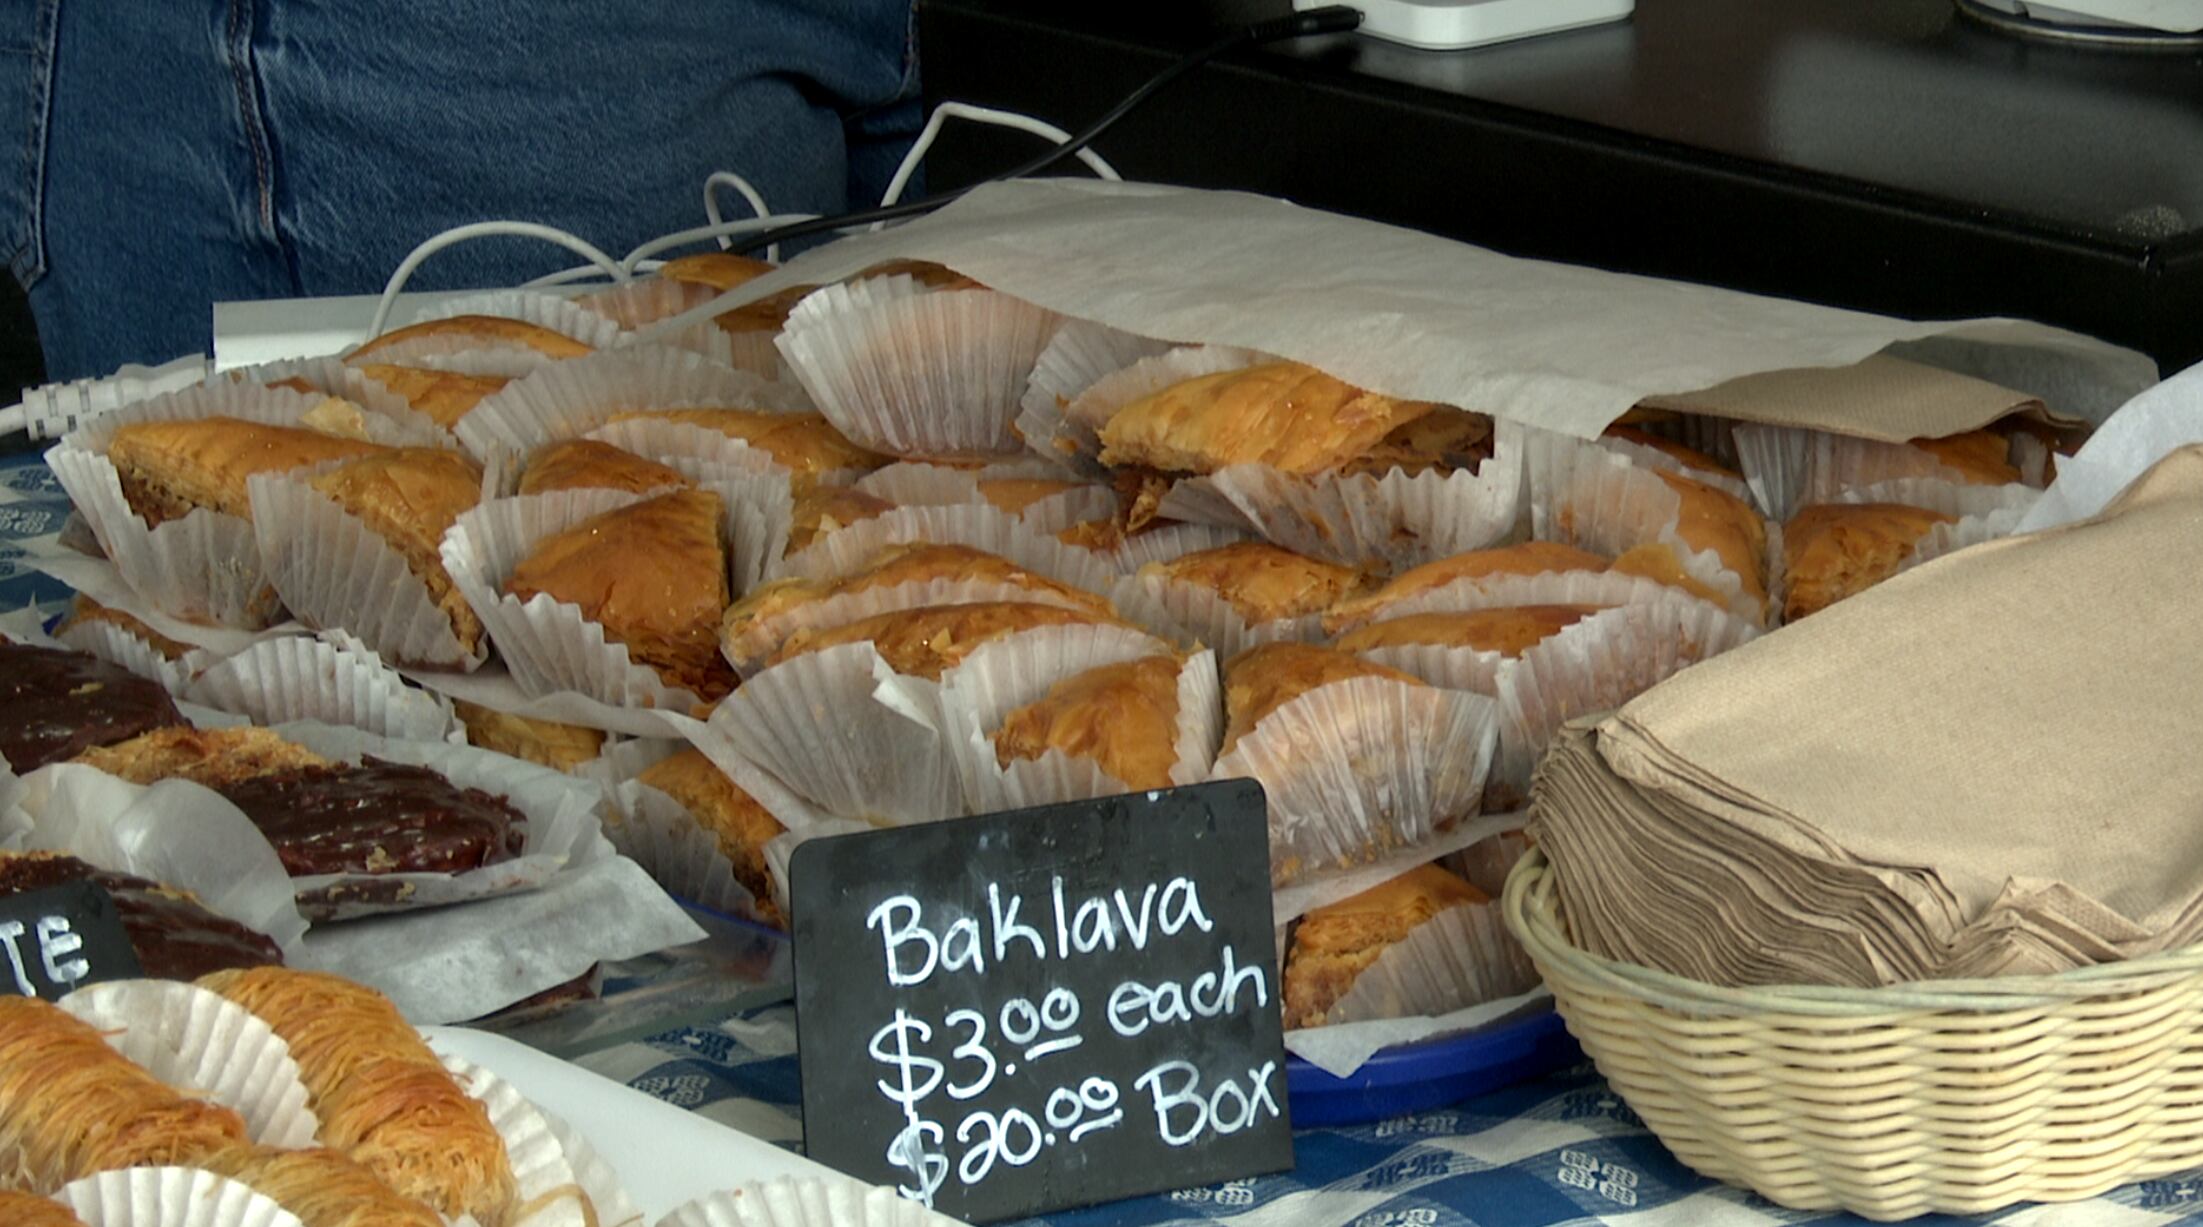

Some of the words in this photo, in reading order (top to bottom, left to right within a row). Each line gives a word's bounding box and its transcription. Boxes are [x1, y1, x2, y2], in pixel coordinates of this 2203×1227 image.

[866, 875, 1213, 986] Baklava
[1107, 945, 1267, 1037] each
[1134, 1060, 1280, 1146] Box
